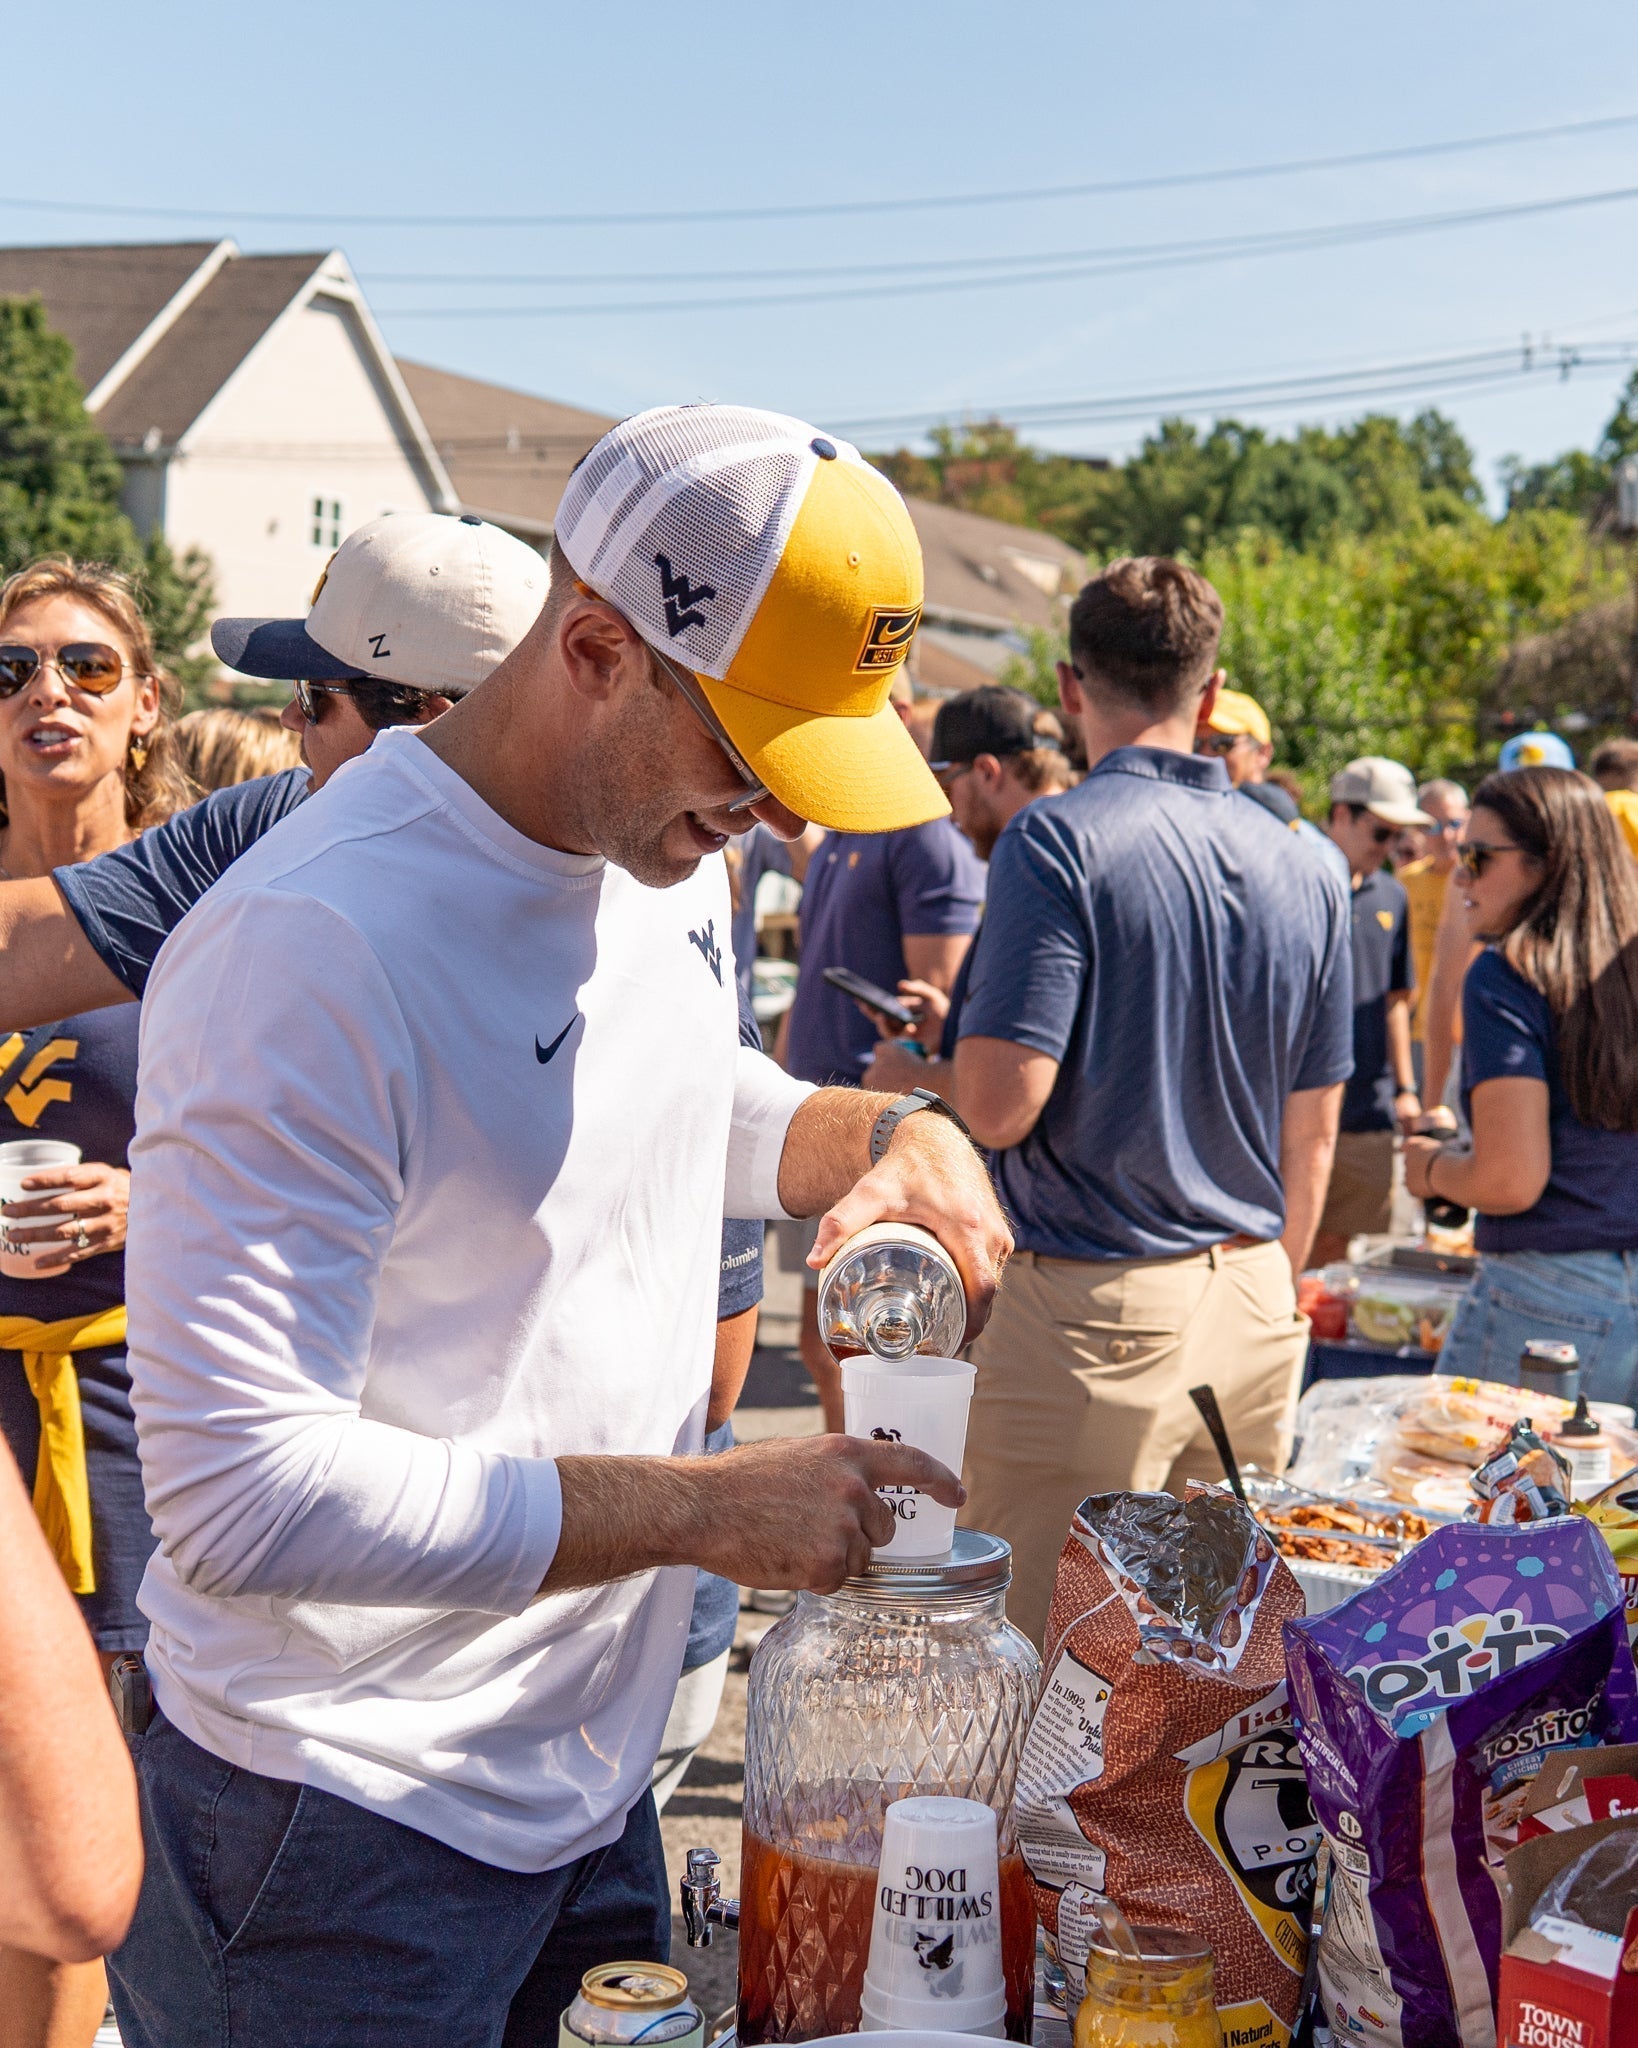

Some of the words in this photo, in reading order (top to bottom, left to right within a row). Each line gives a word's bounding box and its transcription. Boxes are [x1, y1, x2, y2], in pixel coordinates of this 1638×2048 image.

[368, 634, 391, 658] Z
[721, 1245, 759, 1271] olumbia
[880, 1497, 917, 1520] OG
[1052, 1680, 1062, 1695] In
[1063, 1688, 1085, 1713] 1992,
[1054, 1698, 1066, 1710] fired
[1066, 1707, 1073, 1715] up
[1051, 1708, 1061, 1719] first
[1061, 1715, 1074, 1727] little
[1055, 1723, 1065, 1733] and
[1051, 1733, 1069, 1748] making
[1046, 1751, 1054, 1761] Our
[1058, 1749, 1066, 1758] the
[1310, 1739, 1341, 1771] ARTIFICIAL
[905, 1866, 966, 1893] DOG
[881, 1887, 992, 1921] SWILLED
[1231, 2020, 1273, 2047] Natural
[1520, 2002, 1583, 2042] TOWN
